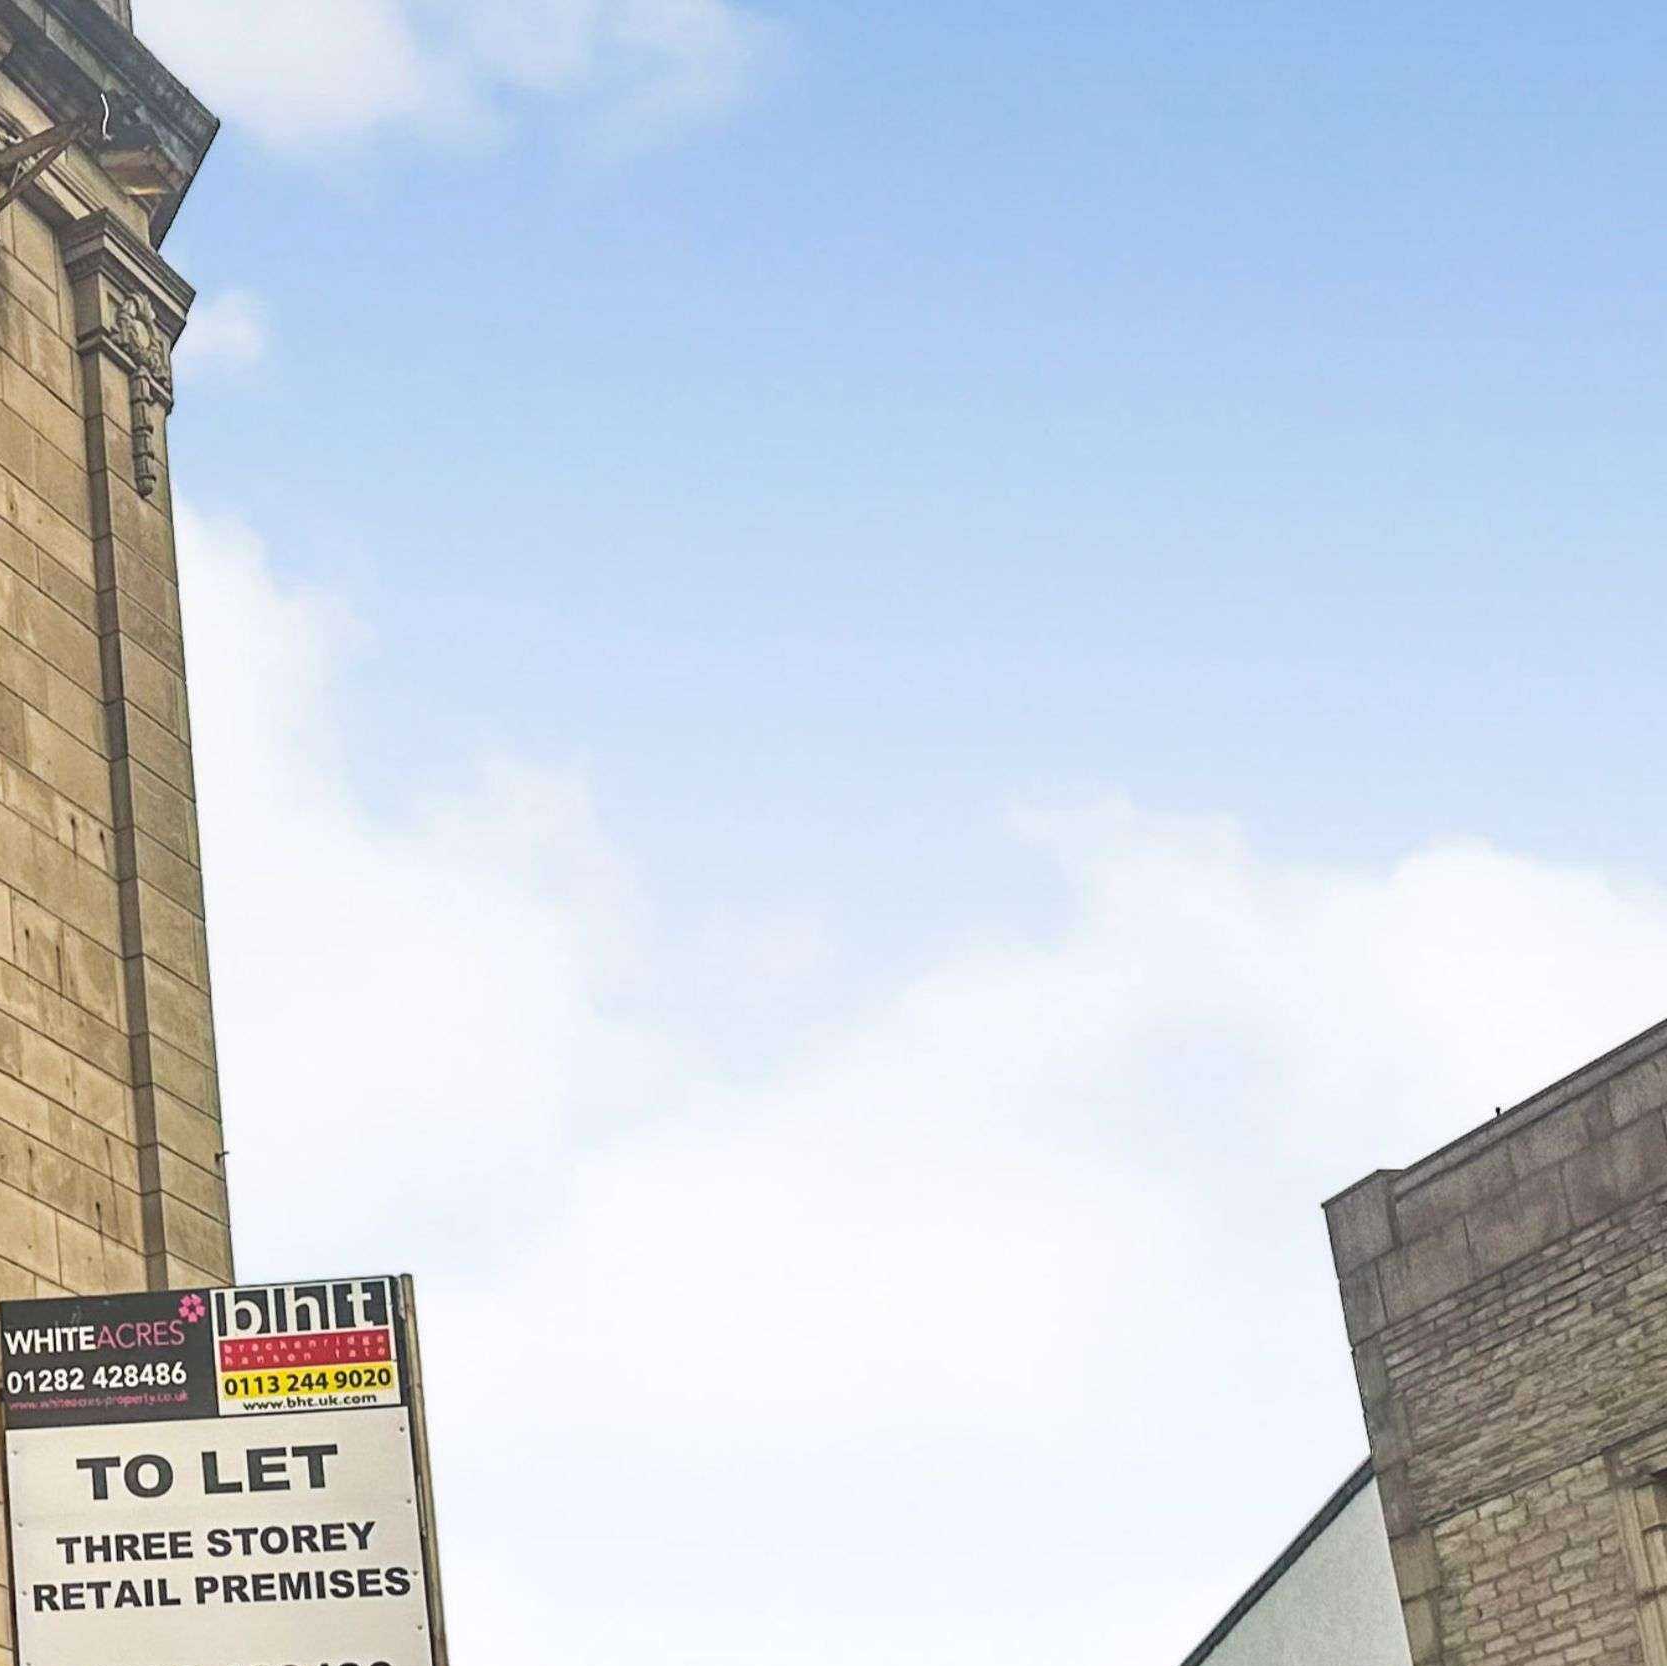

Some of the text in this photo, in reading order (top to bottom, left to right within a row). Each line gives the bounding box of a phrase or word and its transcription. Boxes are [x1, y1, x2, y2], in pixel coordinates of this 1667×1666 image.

[222, 1282, 376, 1338] bht
[3, 1319, 185, 1356] WHITEACRES
[6, 1361, 188, 1395] 01282 428486
[224, 1367, 392, 1396] 0113 244 9020
[243, 1393, 377, 1411] www.bht.uk.com
[76, 1443, 338, 1501] TO LET
[56, 1521, 377, 1565] THREE STOREY
[32, 1566, 412, 1613] RETAIL PREMISES
